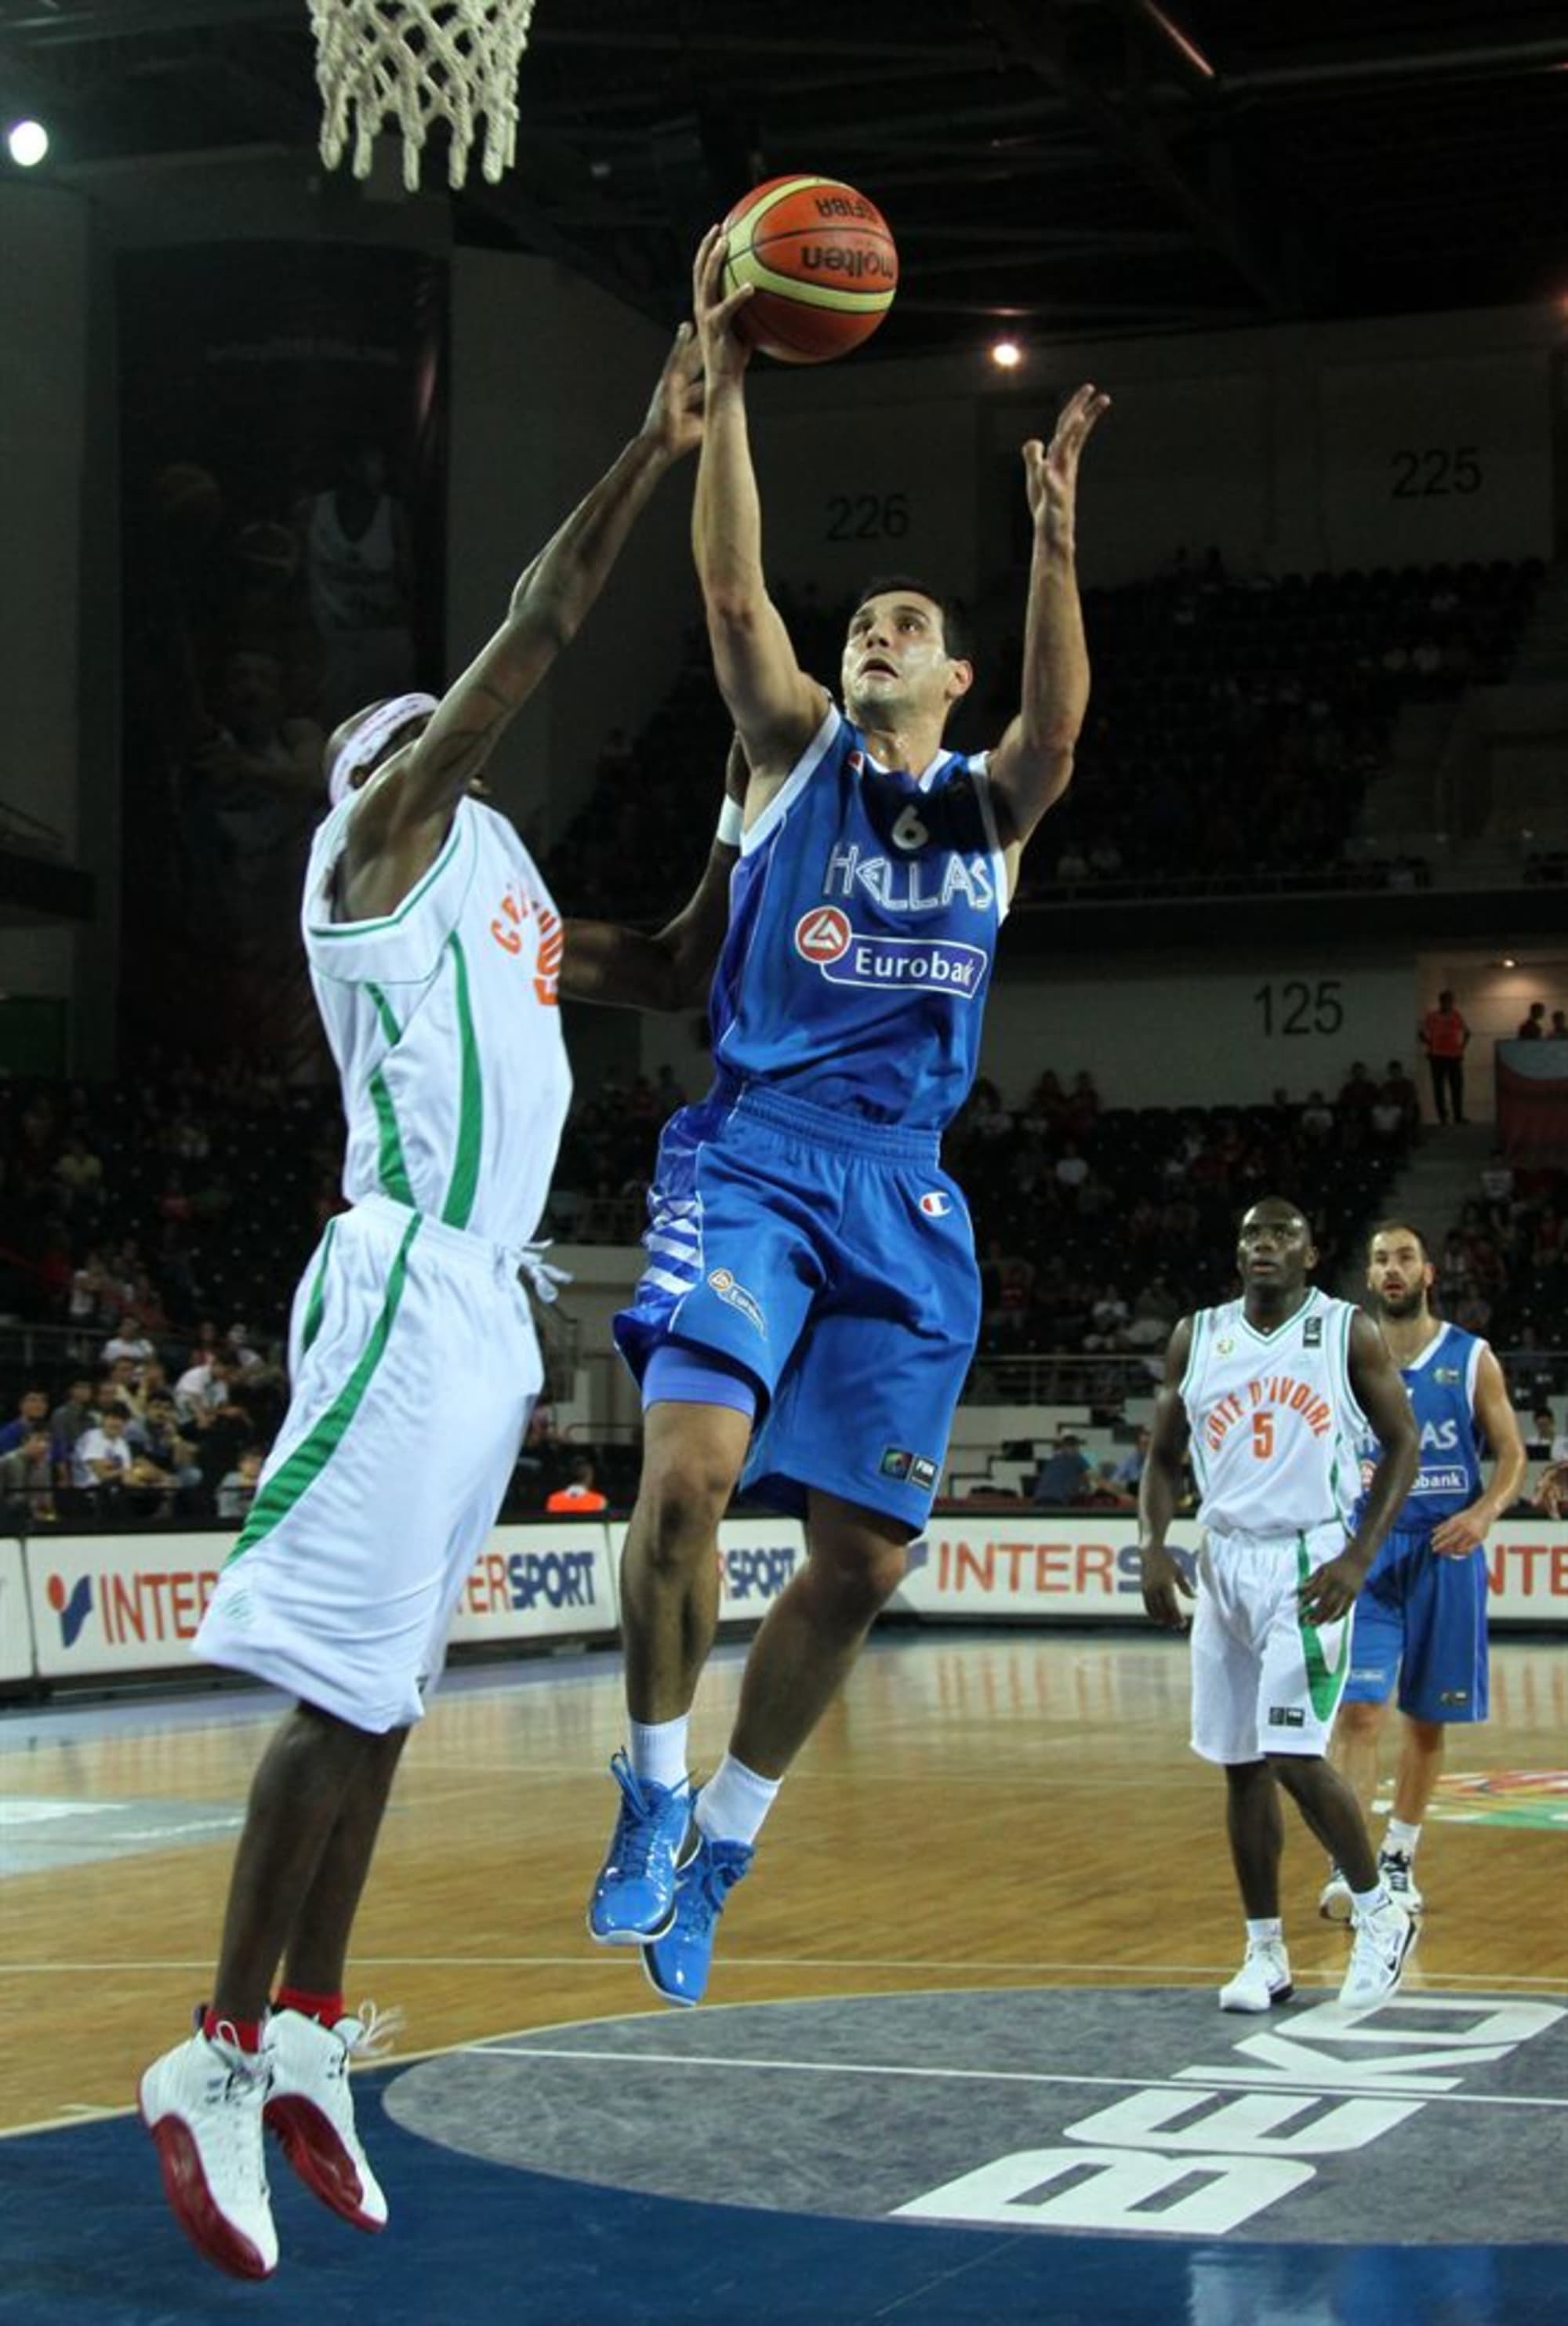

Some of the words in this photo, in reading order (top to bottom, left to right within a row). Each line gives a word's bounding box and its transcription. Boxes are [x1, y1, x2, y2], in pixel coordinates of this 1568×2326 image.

[801, 245, 894, 278] molten
[1392, 446, 1483, 498] 225
[827, 494, 909, 541] 226
[891, 804, 928, 850] 6
[855, 947, 975, 985] Euroba
[1254, 981, 1344, 1037] 125
[1252, 1412, 1274, 1459] 5
[1413, 1472, 1462, 1490] bank
[458, 1551, 596, 1613] ERSPORT
[938, 1541, 1198, 1593] INTERS
[1487, 1544, 1568, 1596] NTE
[887, 1997, 1566, 2235] BEKO
